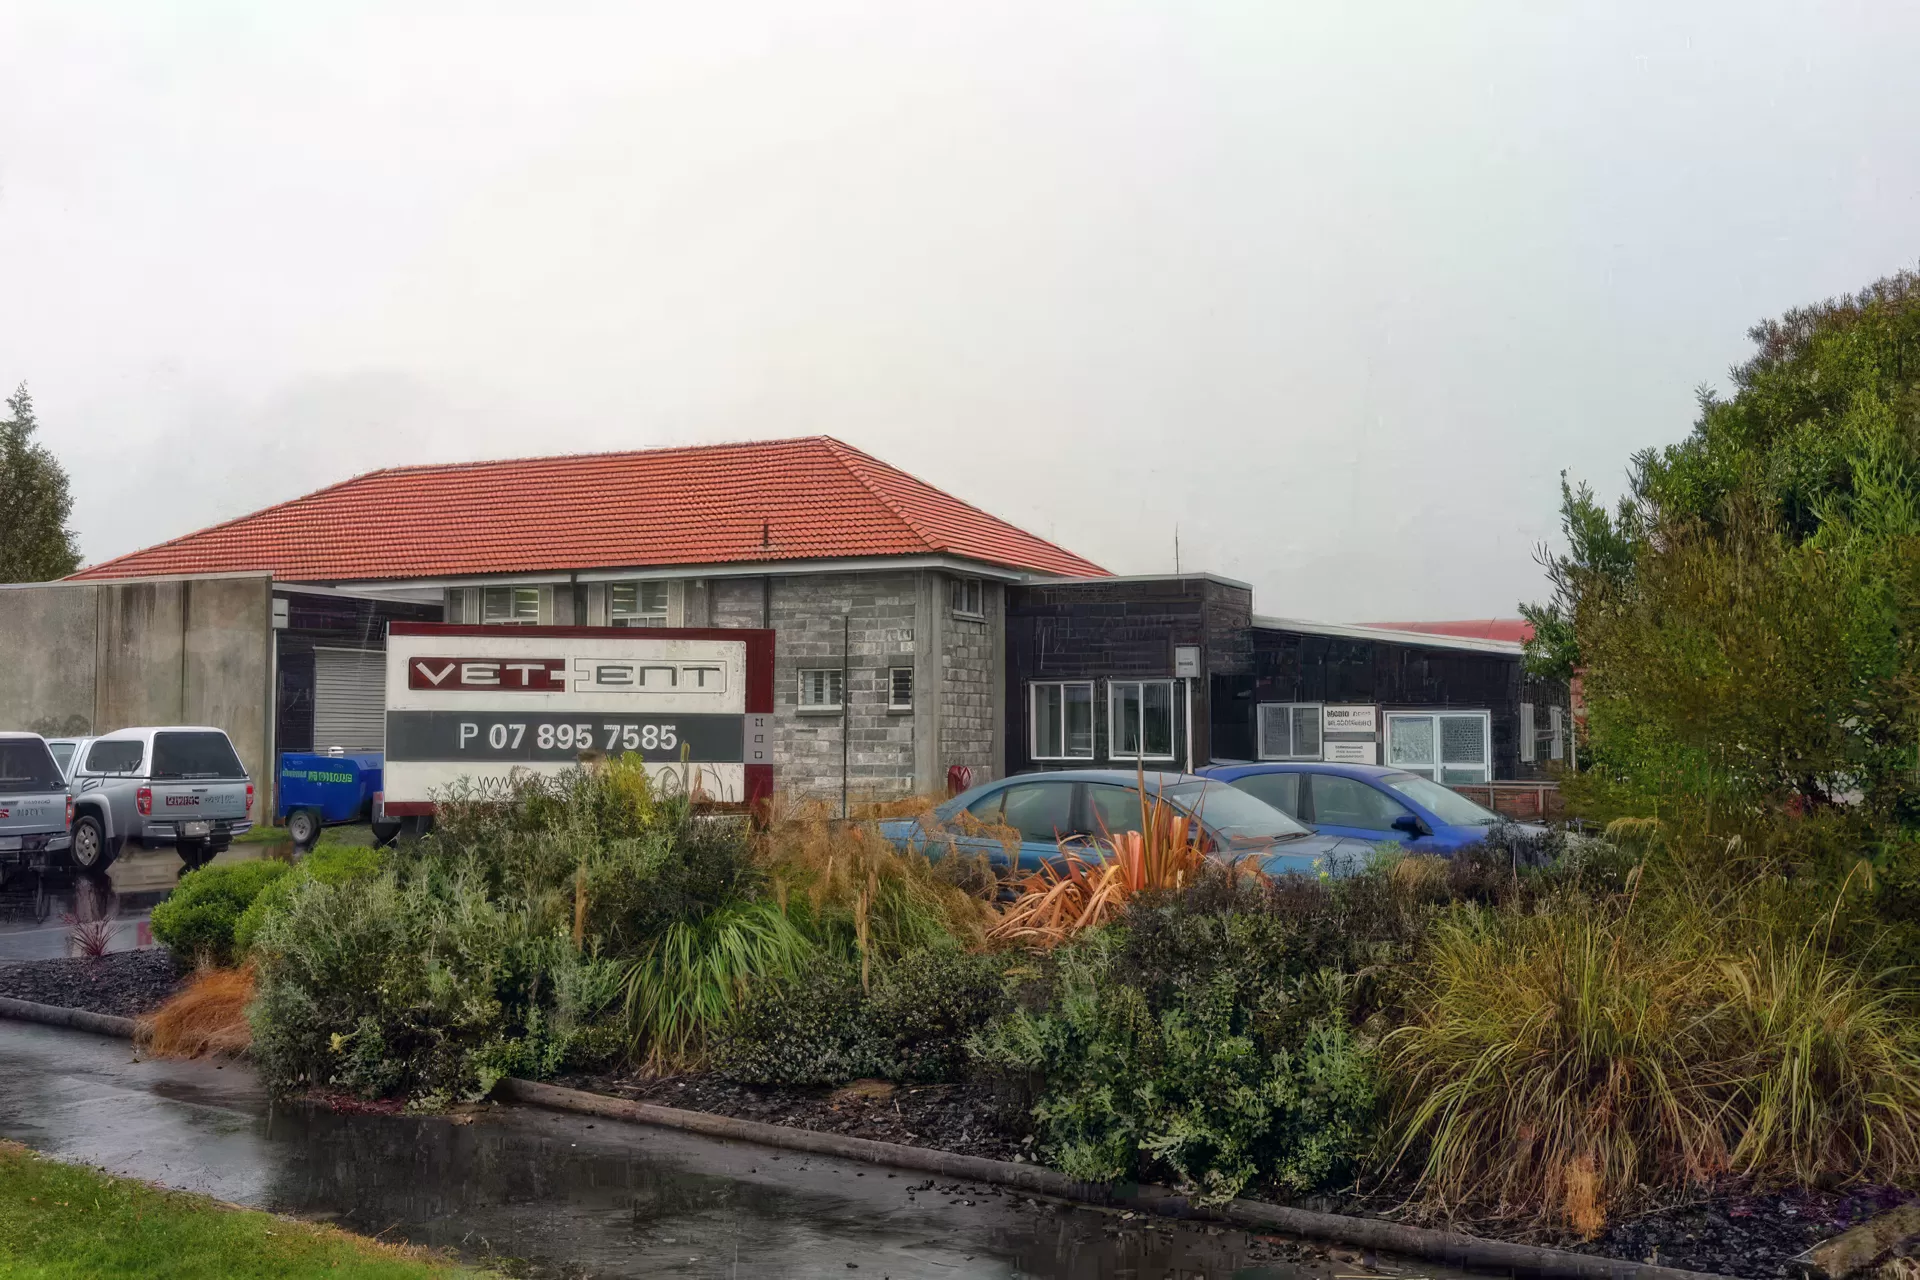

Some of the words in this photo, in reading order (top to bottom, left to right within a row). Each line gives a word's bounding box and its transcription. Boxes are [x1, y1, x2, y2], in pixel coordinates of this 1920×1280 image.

[459, 722, 479, 749] P
[488, 723, 527, 750] 07
[536, 723, 593, 750] 895
[603, 724, 678, 750] 7585
